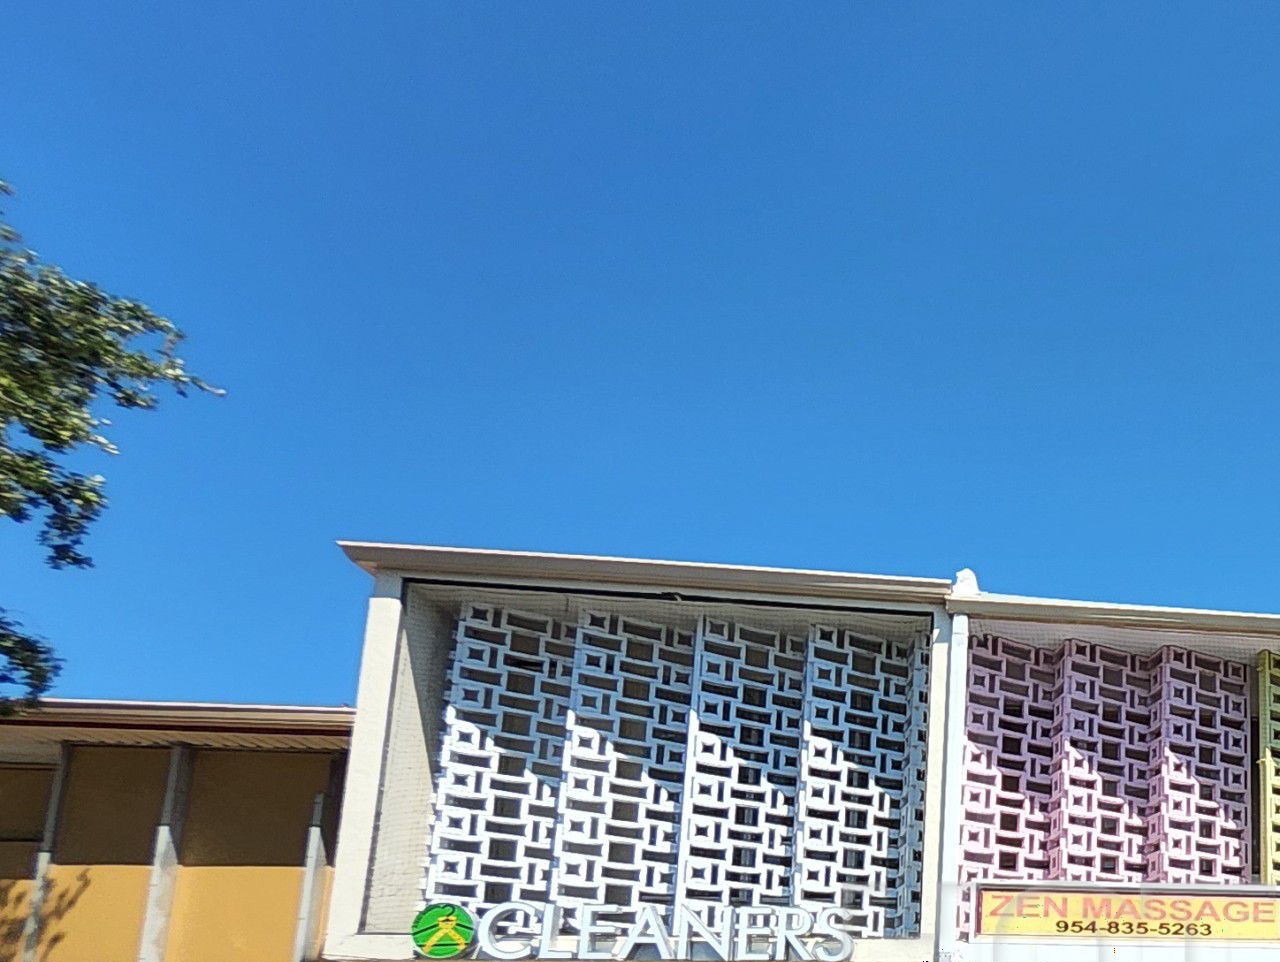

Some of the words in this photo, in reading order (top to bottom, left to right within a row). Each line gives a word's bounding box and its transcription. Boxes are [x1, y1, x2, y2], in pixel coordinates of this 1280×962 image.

[990, 895, 1068, 917] ZEN
[1082, 898, 1276, 922] MASSAGE
[478, 901, 855, 962] CLEANERS
[1056, 920, 1212, 936] 954-835-5263
